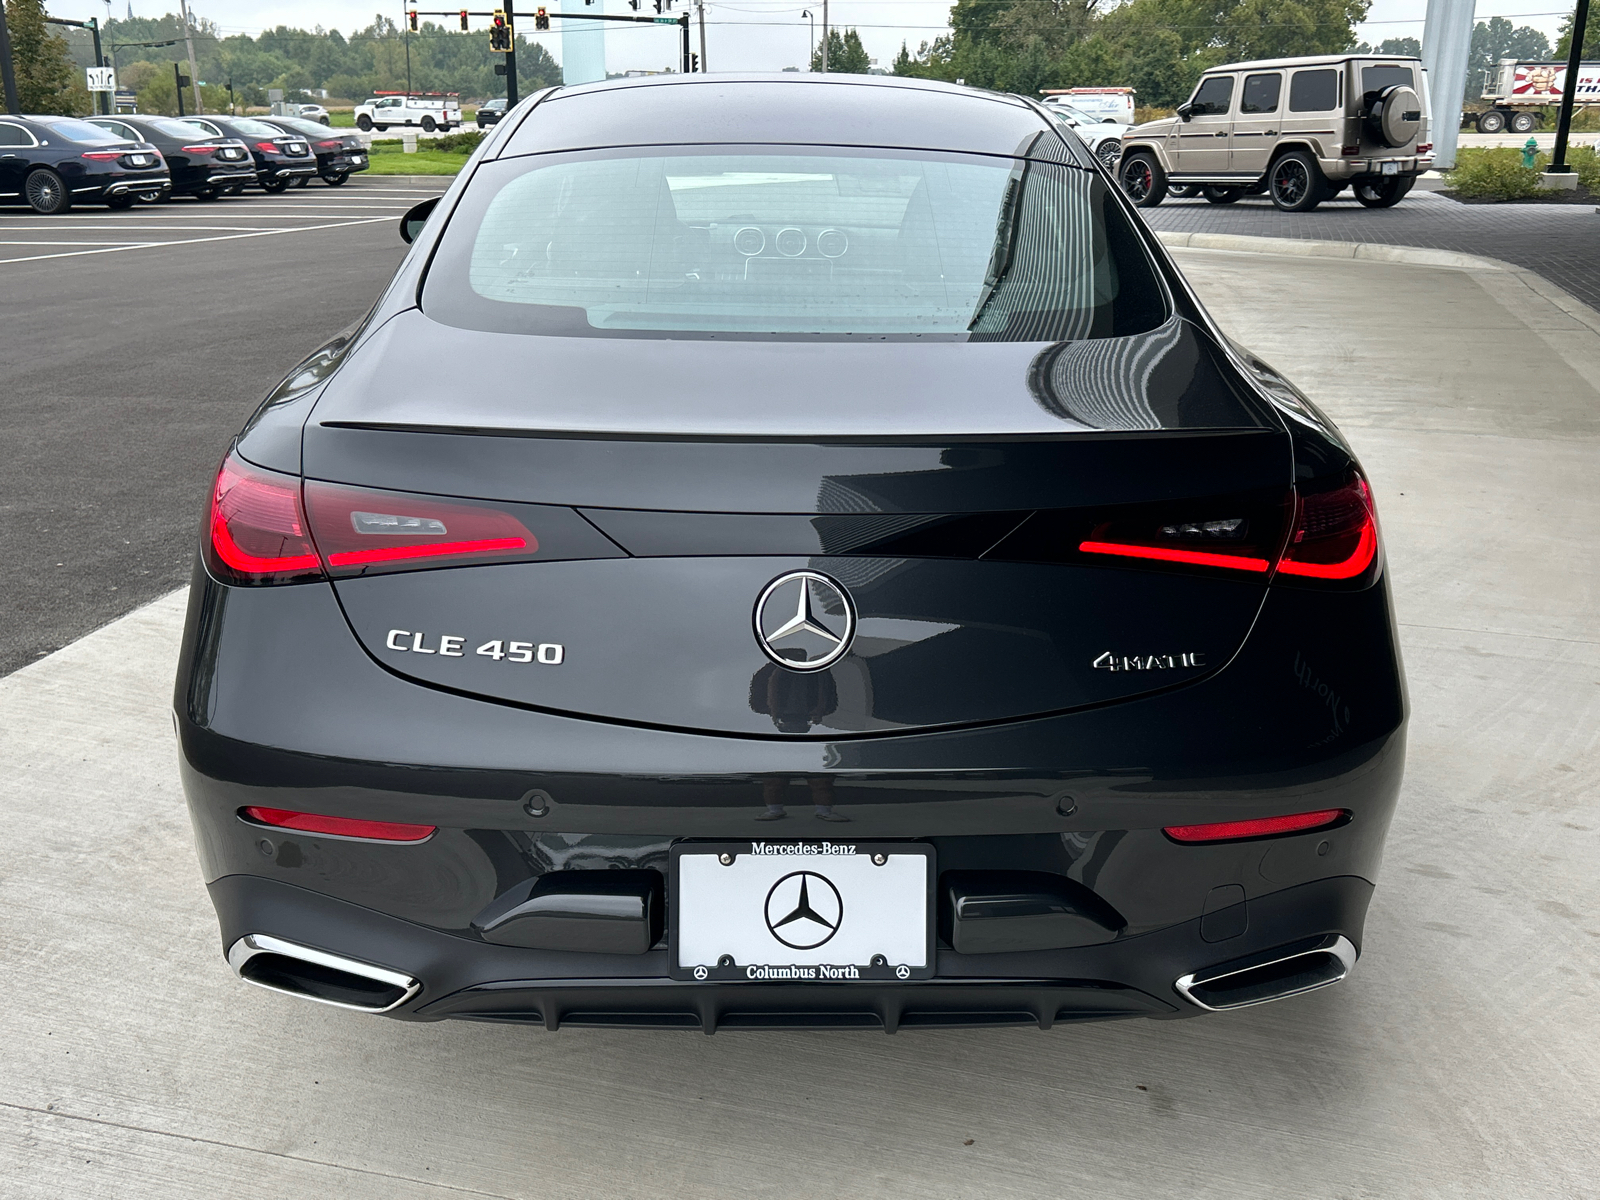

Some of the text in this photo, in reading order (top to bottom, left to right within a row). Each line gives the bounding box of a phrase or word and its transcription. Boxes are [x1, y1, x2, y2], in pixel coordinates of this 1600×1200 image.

[386, 629, 565, 665] CLE 450
[1092, 651, 1206, 672] 4MATIC
[751, 841, 857, 855] Mercedes-Benz
[746, 965, 860, 979] Columbus North
